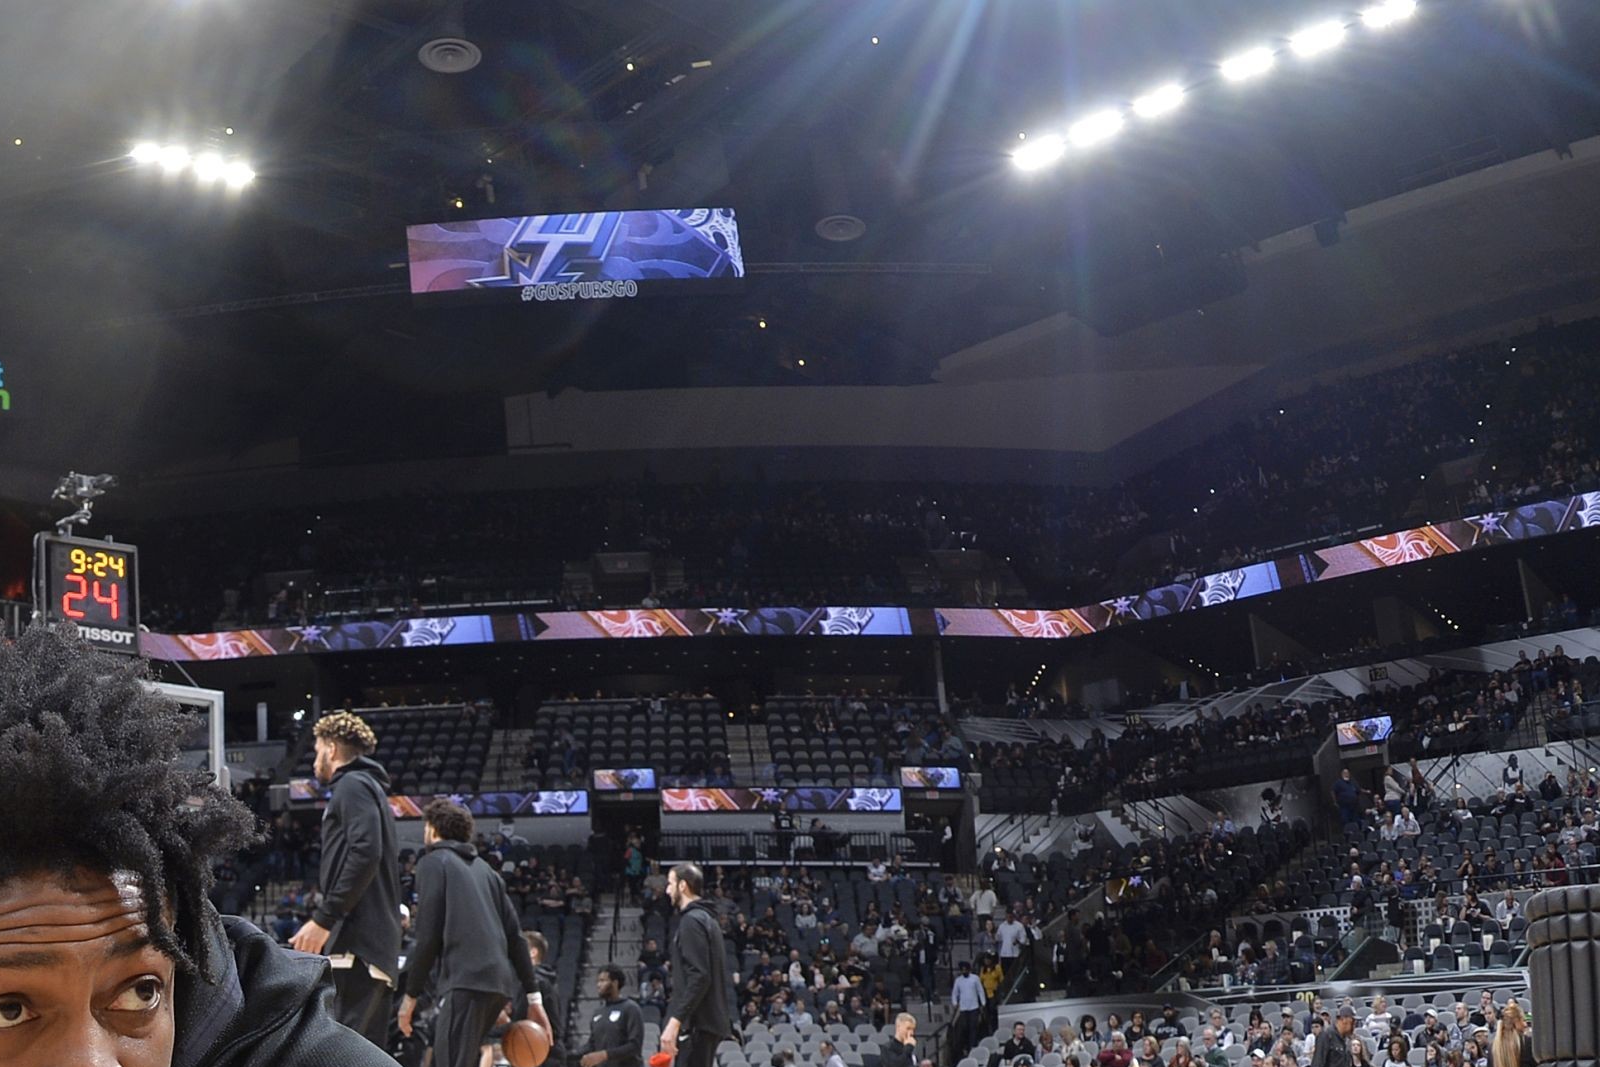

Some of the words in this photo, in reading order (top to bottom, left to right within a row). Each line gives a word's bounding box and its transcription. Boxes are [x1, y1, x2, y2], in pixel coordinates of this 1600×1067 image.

[521, 280, 638, 301] #GOSPURSGO
[70, 548, 124, 578] 9:24
[62, 573, 118, 620] 24
